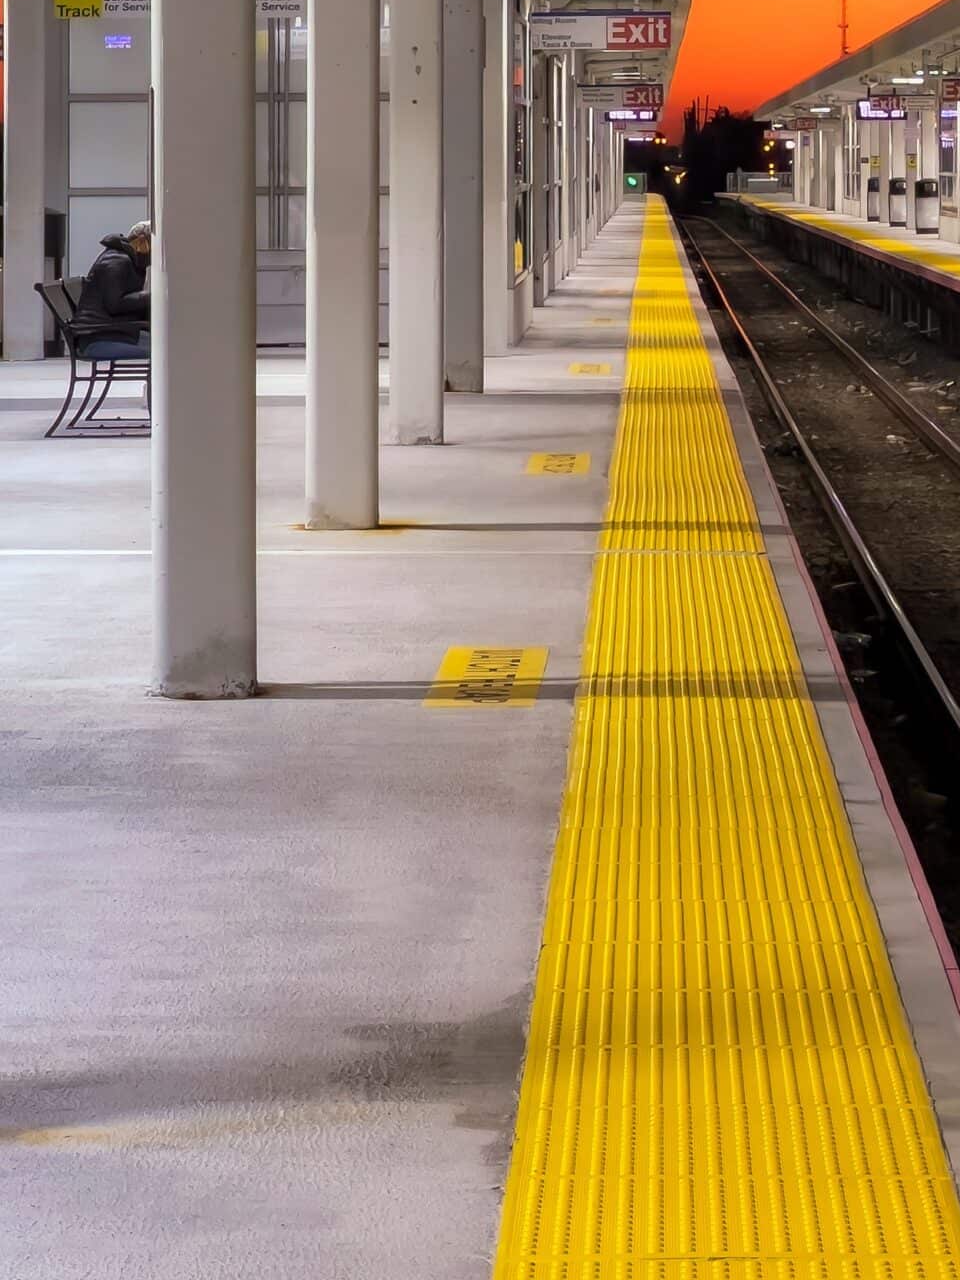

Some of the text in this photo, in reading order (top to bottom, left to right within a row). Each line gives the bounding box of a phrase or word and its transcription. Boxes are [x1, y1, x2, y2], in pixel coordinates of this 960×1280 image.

[56, 4, 100, 17] Track
[104, 2, 120, 11] for
[261, 2, 301, 11] Service
[607, 17, 667, 44] Exit
[623, 87, 661, 105] Exit
[870, 96, 898, 110] Exit
